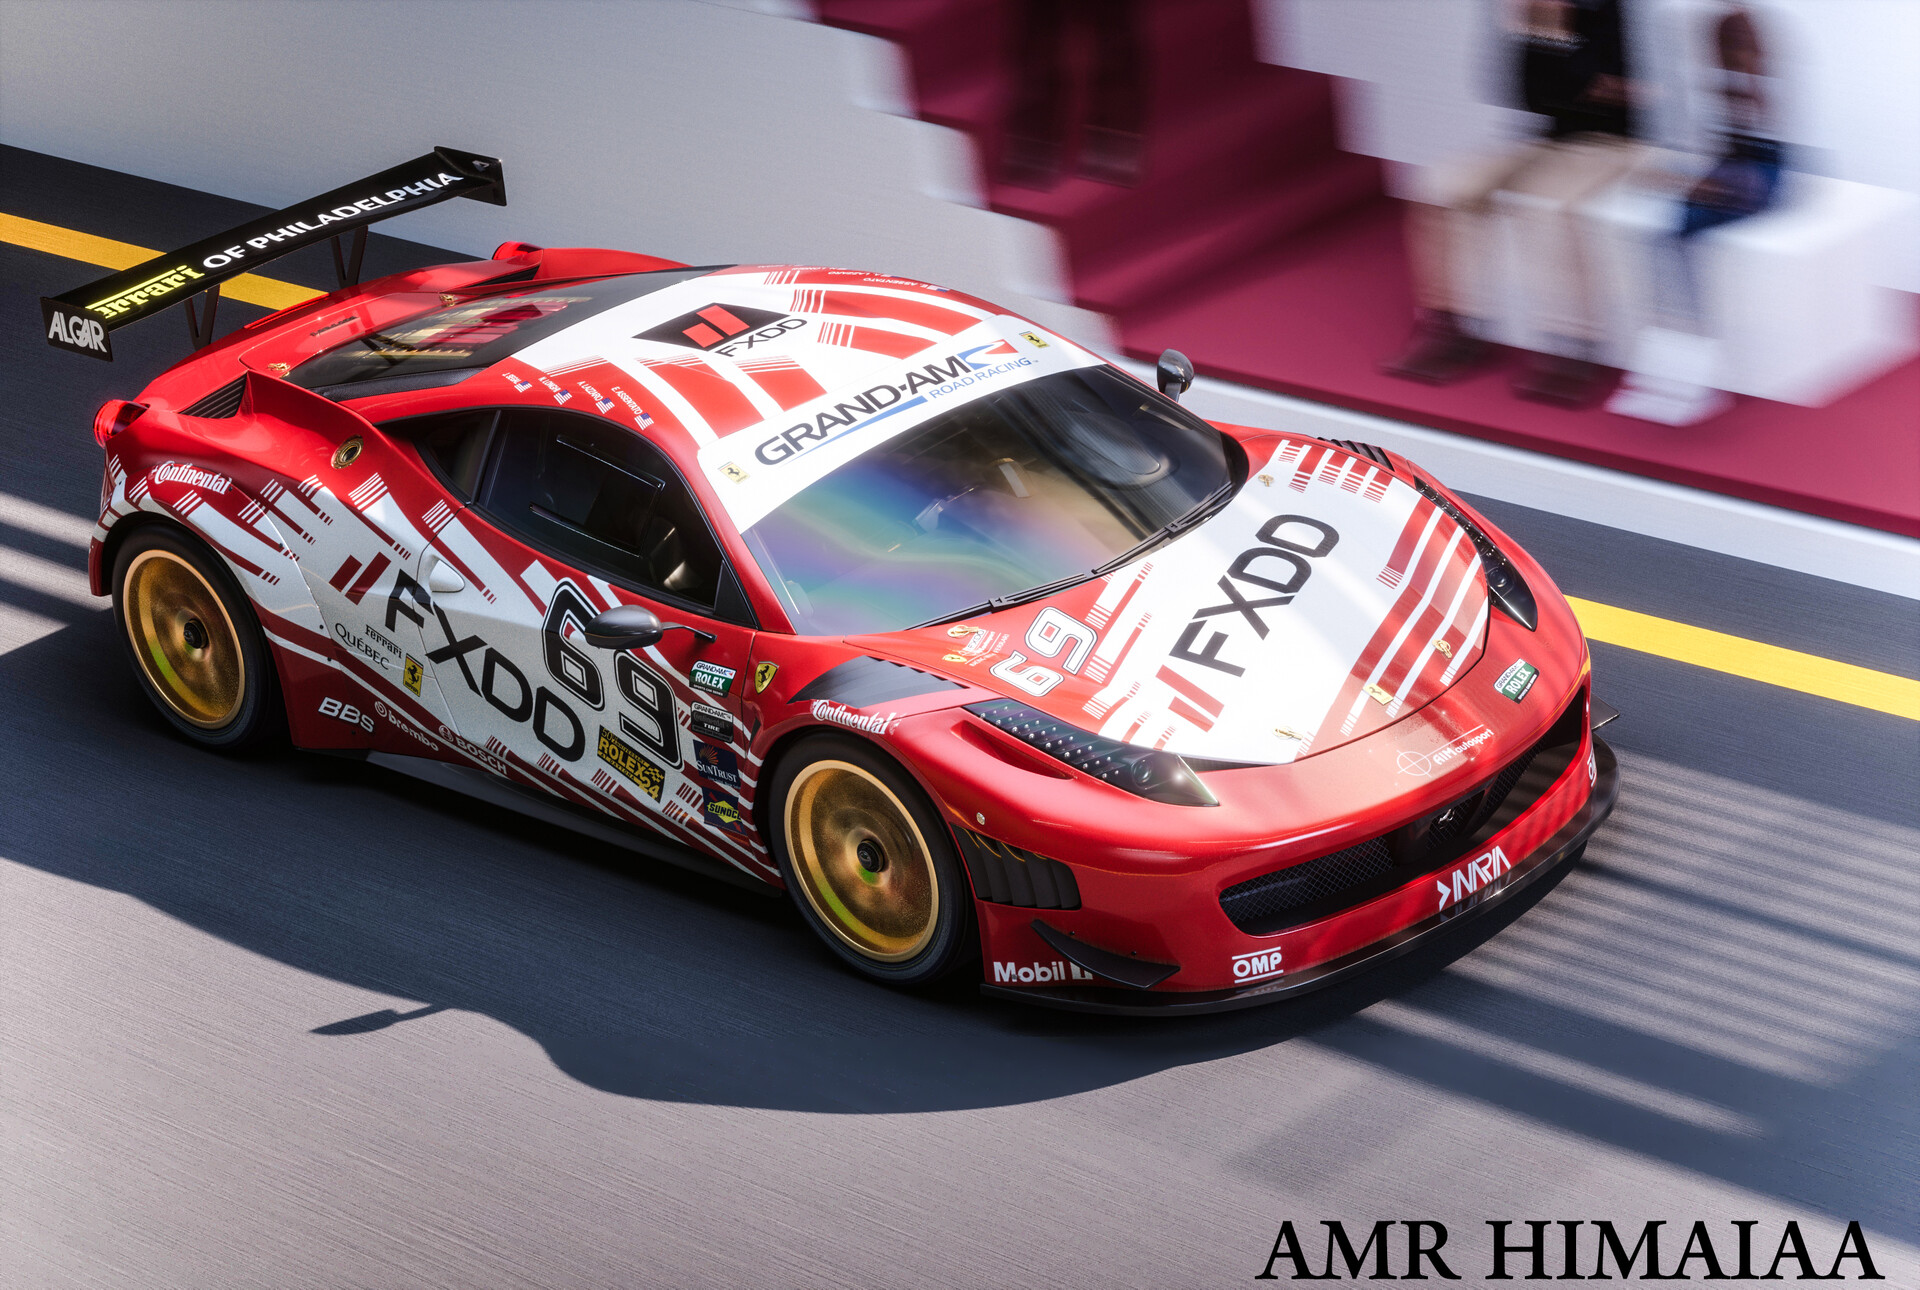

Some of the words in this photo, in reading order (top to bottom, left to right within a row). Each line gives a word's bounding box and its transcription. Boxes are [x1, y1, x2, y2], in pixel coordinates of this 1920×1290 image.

[203, 245, 246, 269] OF
[246, 172, 464, 249] PHILADELPHIA
[48, 311, 108, 353] ALGAR
[714, 318, 808, 358] FXDD
[929, 376, 975, 399] ROAD
[974, 357, 1033, 381] RACING
[154, 460, 232, 496] Continental
[1168, 513, 1340, 678] FXDD
[334, 622, 390, 671] QUÉBEC
[365, 624, 402, 660] Ferrari
[988, 605, 1099, 698] 69
[384, 568, 586, 763] FXDD
[541, 576, 686, 774] 69
[695, 671, 726, 690] ROLEX
[1505, 667, 1532, 695] ROLEX
[318, 696, 375, 733] BBS
[387, 710, 439, 752] brembo
[703, 722, 720, 732] TIRE
[812, 699, 897, 735] Continental
[455, 736, 508, 776] BOSCH
[598, 736, 646, 777] ROLEX
[1432, 746, 1458, 766] AIM
[1454, 728, 1495, 754] autosport
[638, 776, 660, 800] 24
[993, 961, 1067, 983] Mobil
[1233, 951, 1283, 978] OMP
